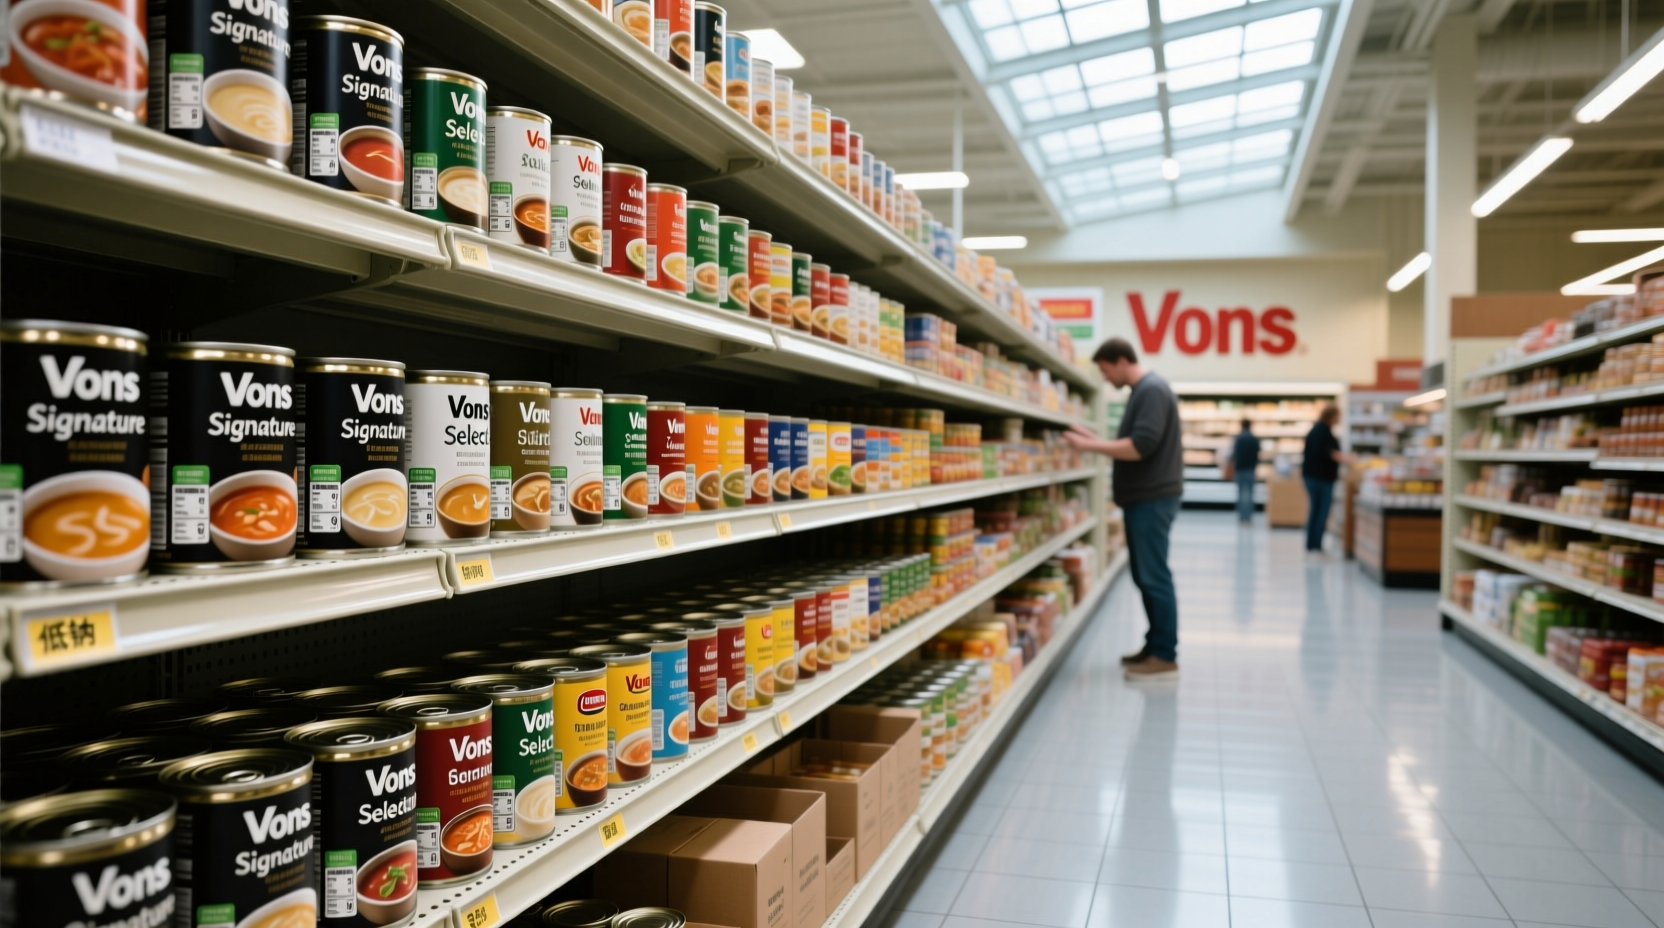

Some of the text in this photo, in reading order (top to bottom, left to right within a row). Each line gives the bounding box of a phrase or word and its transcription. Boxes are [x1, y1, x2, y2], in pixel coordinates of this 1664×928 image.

[352, 42, 402, 83] Vons
[1127, 290, 1297, 355] Vons
[39, 355, 141, 402] Vons
[220, 372, 293, 409] Vons
[351, 384, 404, 415] Vons
[448, 395, 489, 420] Vons
[26, 403, 146, 441] Signature
[208, 412, 296, 442] Signature
[449, 735, 492, 762] Vons
[365, 764, 416, 796] Vons
[243, 802, 312, 844] Vons
[72, 857, 172, 916] Vons
